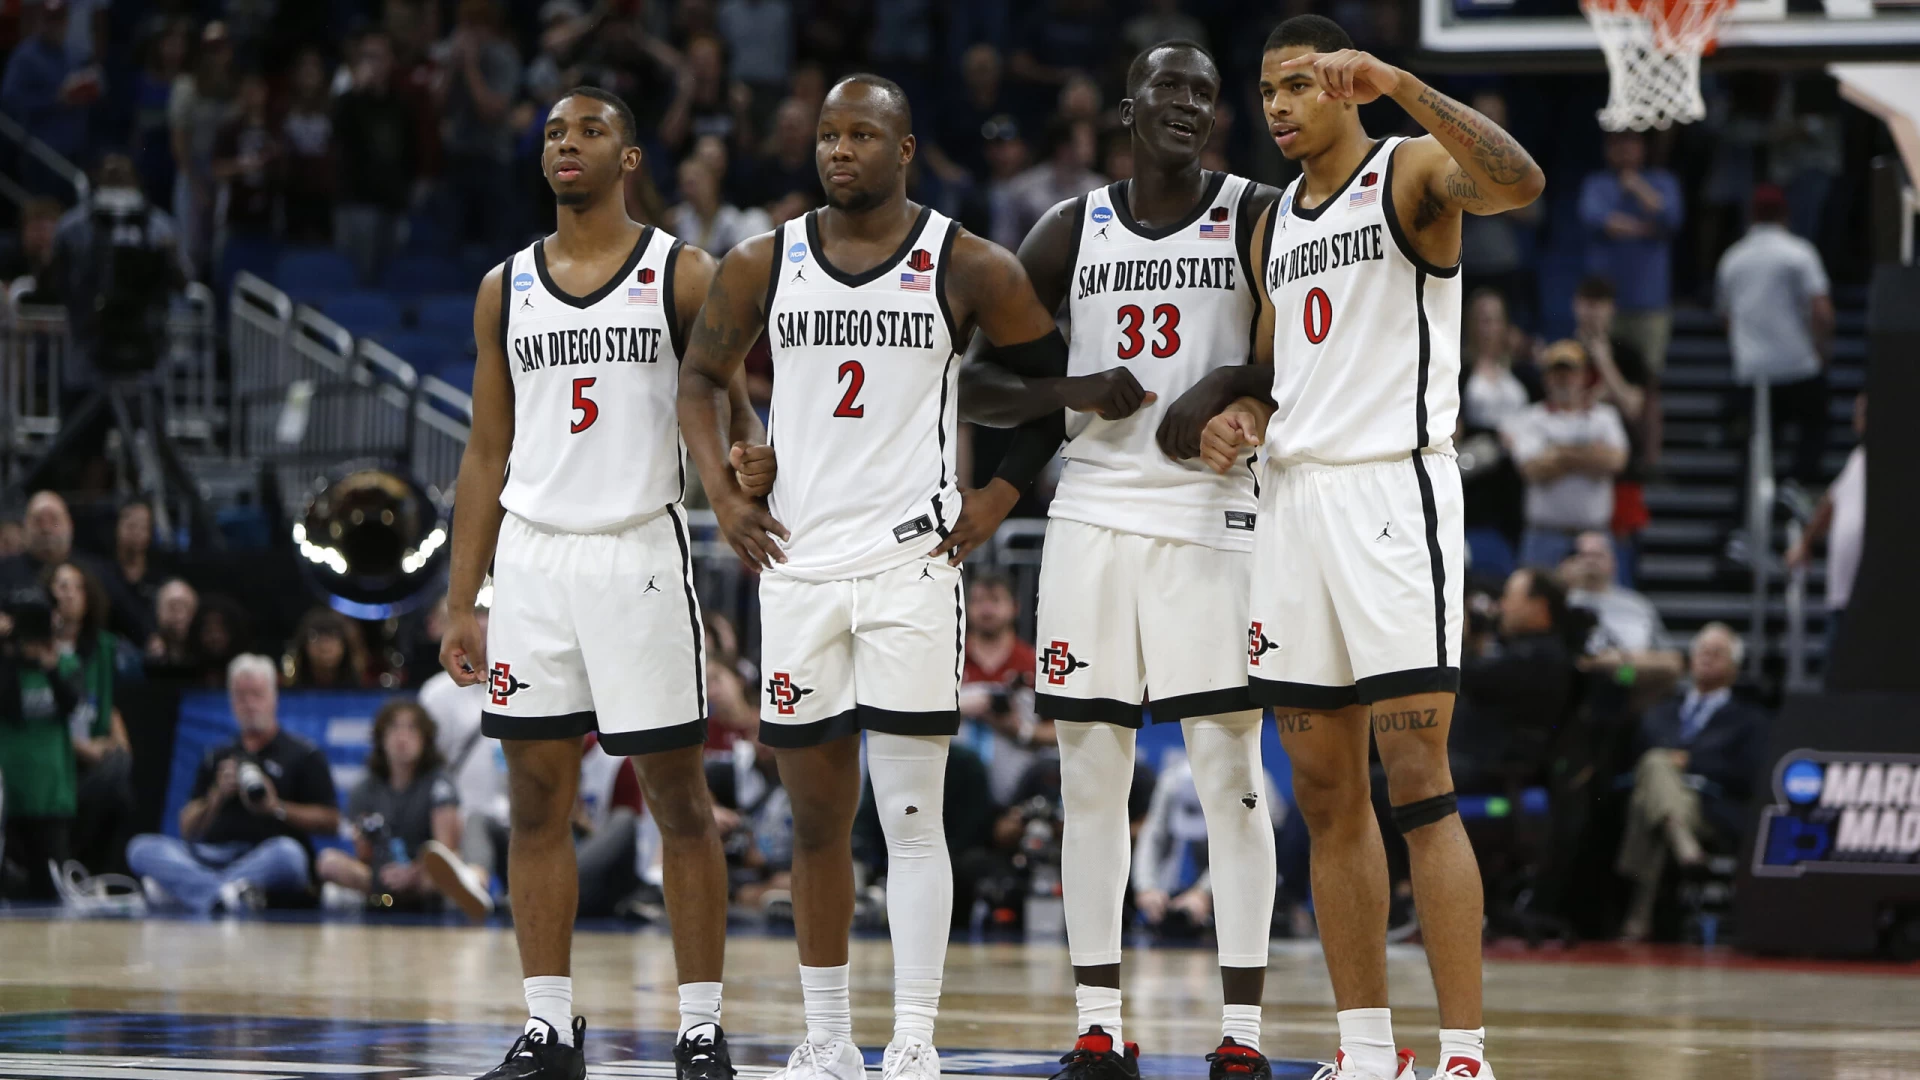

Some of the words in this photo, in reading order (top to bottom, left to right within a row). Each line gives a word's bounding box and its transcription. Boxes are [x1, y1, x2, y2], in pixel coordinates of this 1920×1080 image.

[1418, 94, 1429, 105] be
[1429, 101, 1457, 124] bigger
[1456, 120, 1478, 138] than
[1437, 119, 1475, 149] FEAR
[1078, 262, 1112, 300] SAN
[1112, 258, 1172, 292] DIEGO
[1174, 257, 1236, 291] STATE
[1268, 252, 1289, 296] SAN
[1287, 236, 1328, 284] DIEGO
[1331, 223, 1384, 269] STATE
[777, 310, 809, 349] SAN
[812, 309, 872, 347] DIEGO
[876, 309, 935, 350] STATE
[1116, 303, 1181, 360] 33
[1303, 286, 1332, 345] 0
[514, 333, 545, 373] SAN
[547, 326, 601, 367] DIEGO
[605, 326, 662, 364] STATE
[570, 377, 599, 435] 5
[833, 360, 866, 419] 2
